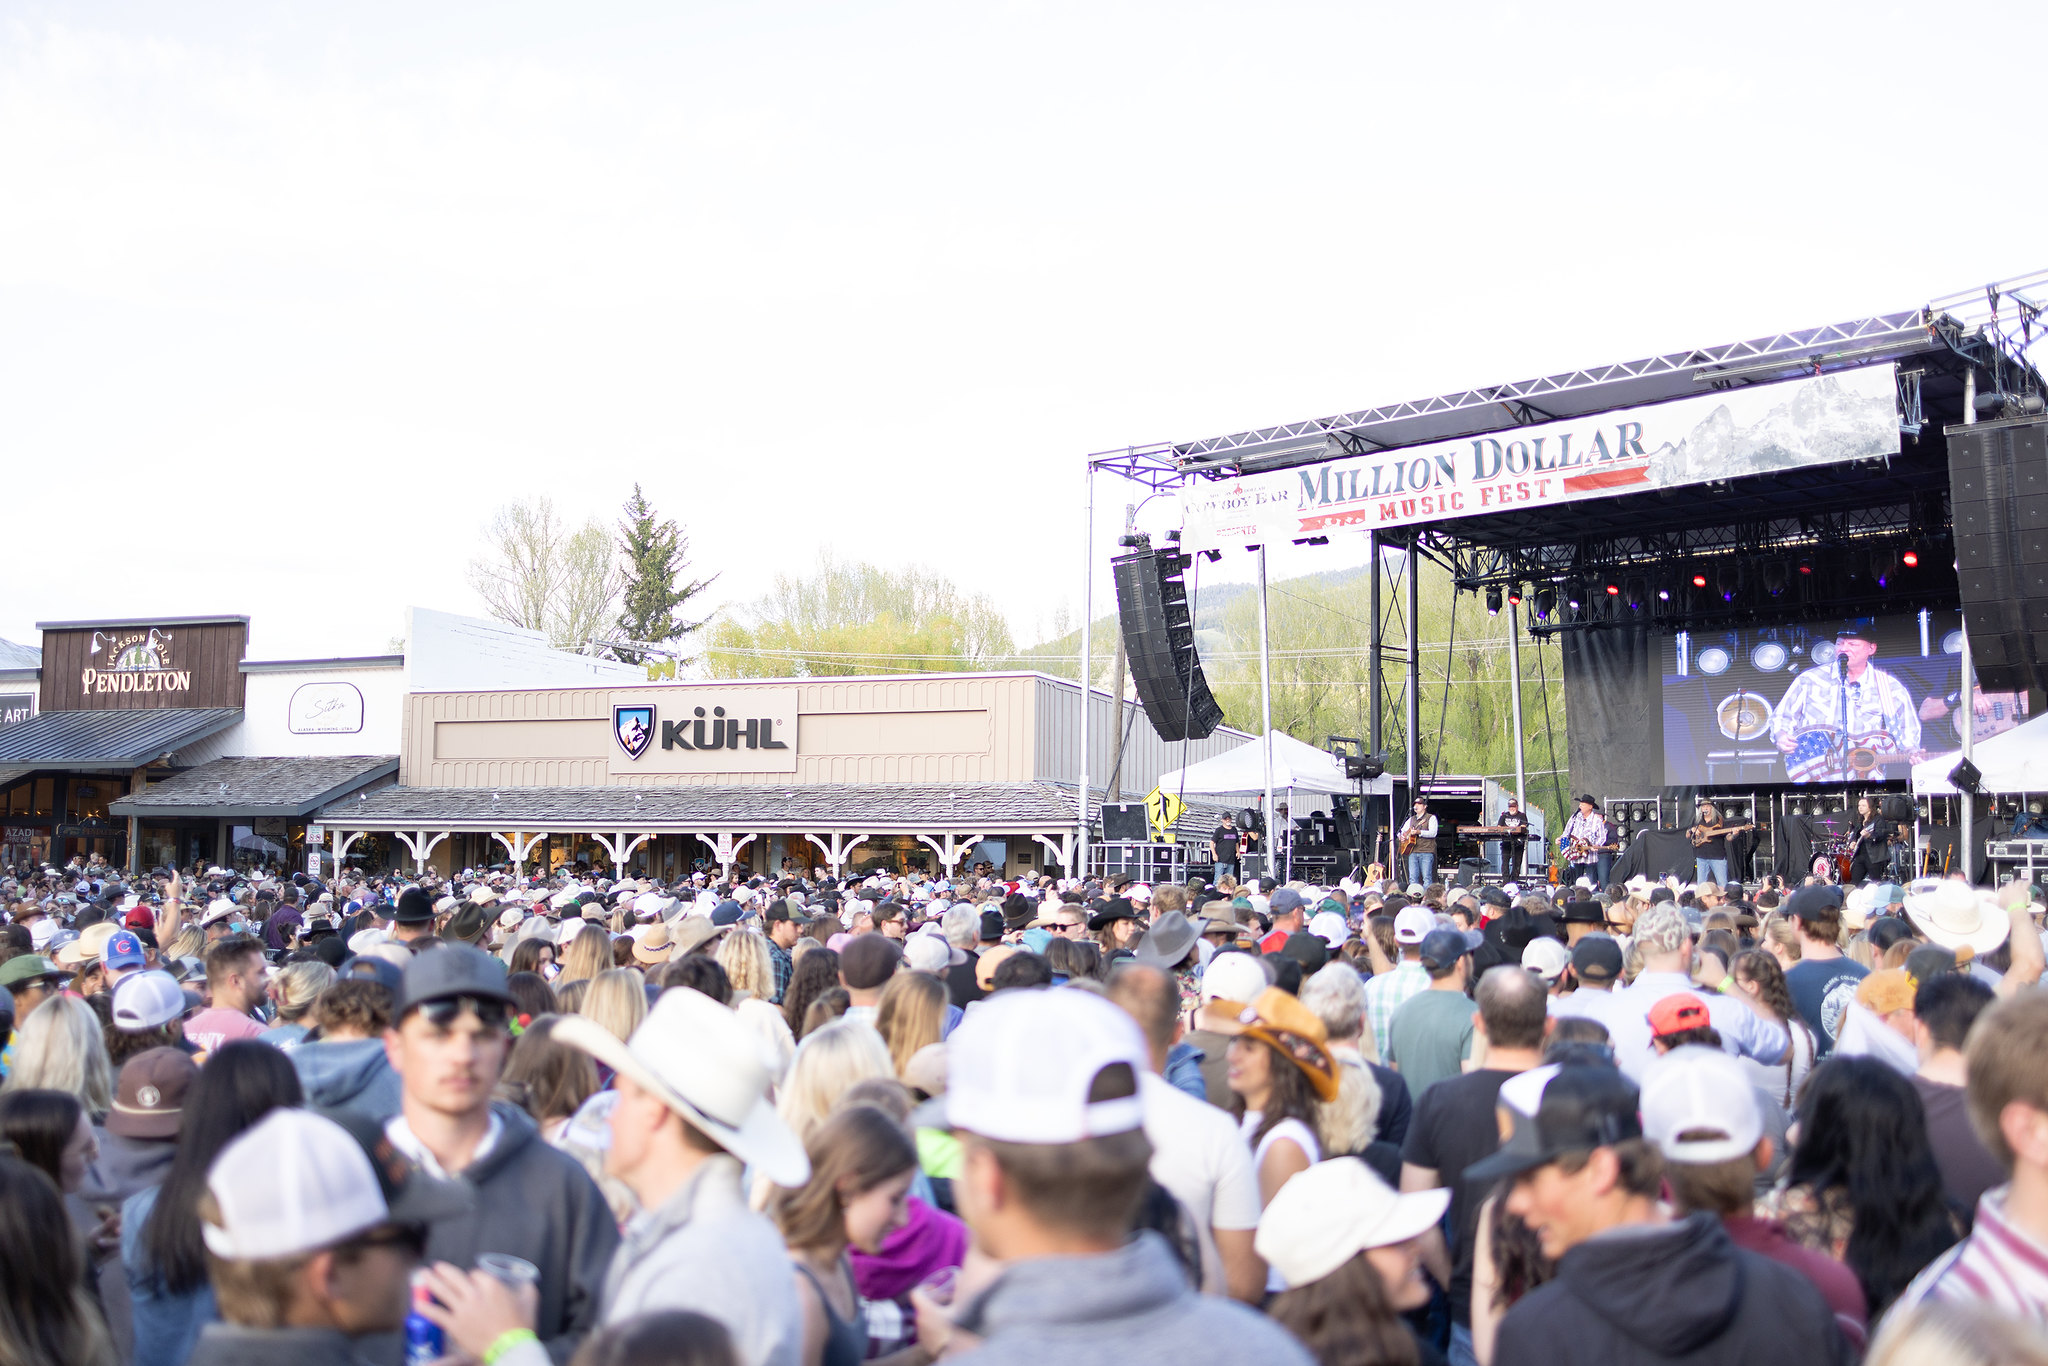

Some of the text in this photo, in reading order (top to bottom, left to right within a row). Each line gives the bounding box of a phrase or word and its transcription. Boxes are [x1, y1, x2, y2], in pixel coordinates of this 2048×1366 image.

[1298, 421, 1649, 510] MILLION DOLLAR
[1379, 479, 1552, 521] MUSIC FEST
[107, 634, 170, 667] JACKSON HOLE
[82, 668, 192, 695] PENDLETON
[4, 708, 30, 723] ART
[5, 828, 35, 837] AZADI
[116, 940, 132, 954] C
